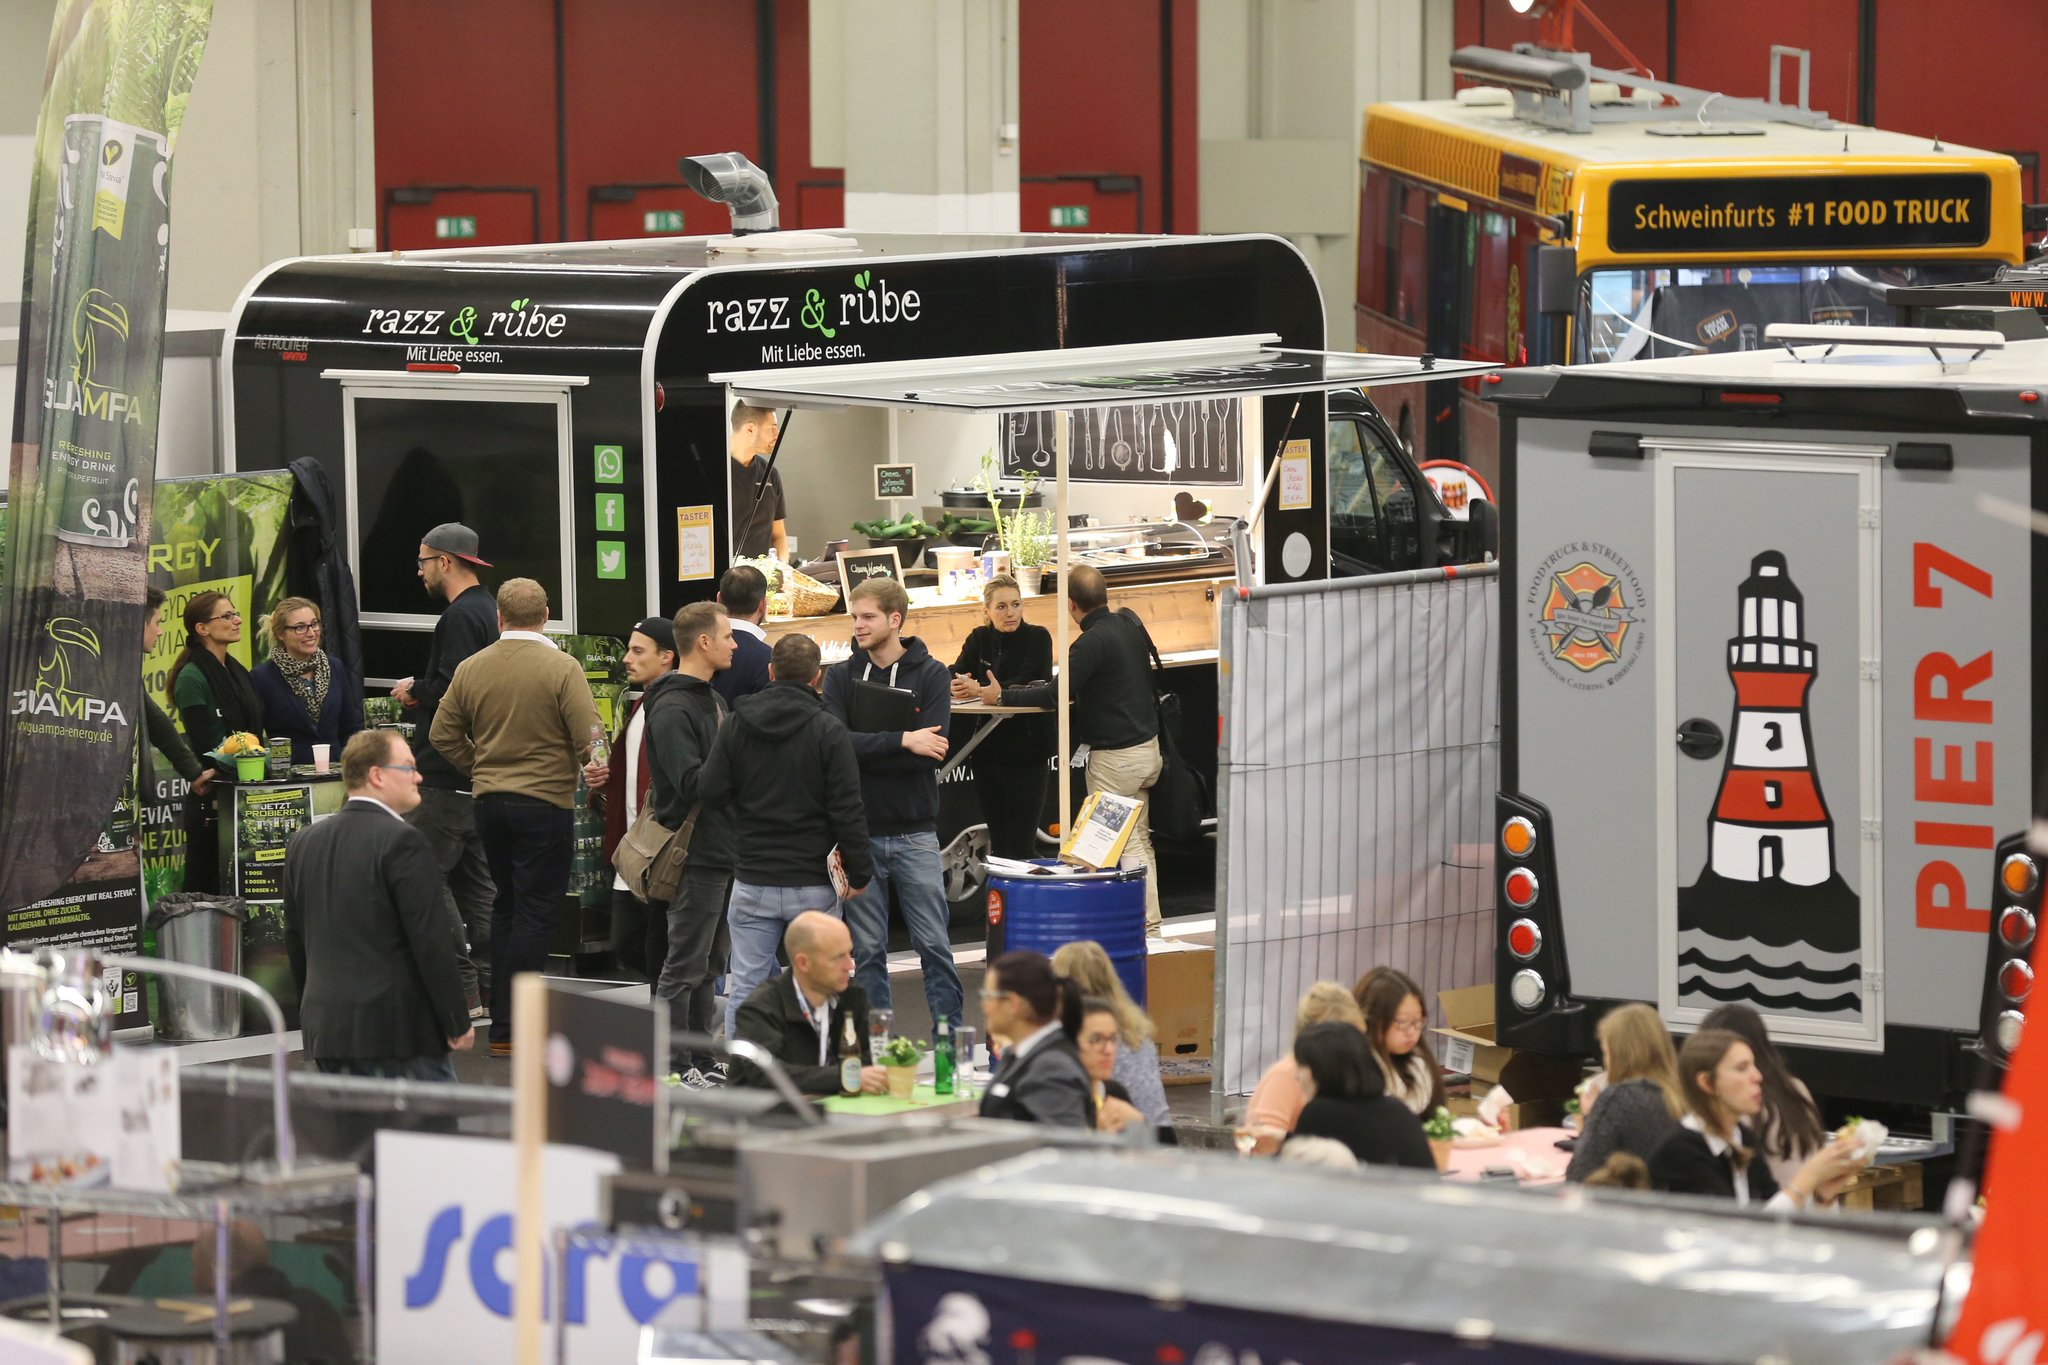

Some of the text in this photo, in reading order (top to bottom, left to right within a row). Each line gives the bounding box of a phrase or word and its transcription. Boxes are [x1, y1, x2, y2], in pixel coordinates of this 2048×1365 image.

[1634, 198, 1970, 230] Schweinfurts #1 FOOD TRUCK
[706, 296, 790, 333] razz
[800, 288, 836, 339] &
[361, 308, 446, 335] razz
[449, 306, 479, 345] &
[406, 346, 504, 363] Mit Liebe essen.
[761, 342, 866, 363] Mit Liebe essen.
[1285, 445, 1307, 454] ASTER
[82, 460, 116, 473] DRINK
[680, 511, 709, 522] TASTER
[585, 654, 617, 662] GUAMPA
[1913, 542, 1995, 934] PIER 7
[65, 895, 86, 904] ENERGY
[87, 893, 98, 901] MIT
[98, 892, 113, 900] REAL
[7, 912, 19, 922] MIT
[43, 907, 59, 917] OHNE
[60, 904, 82, 915] ZUCKER.
[104, 934, 114, 943] Real
